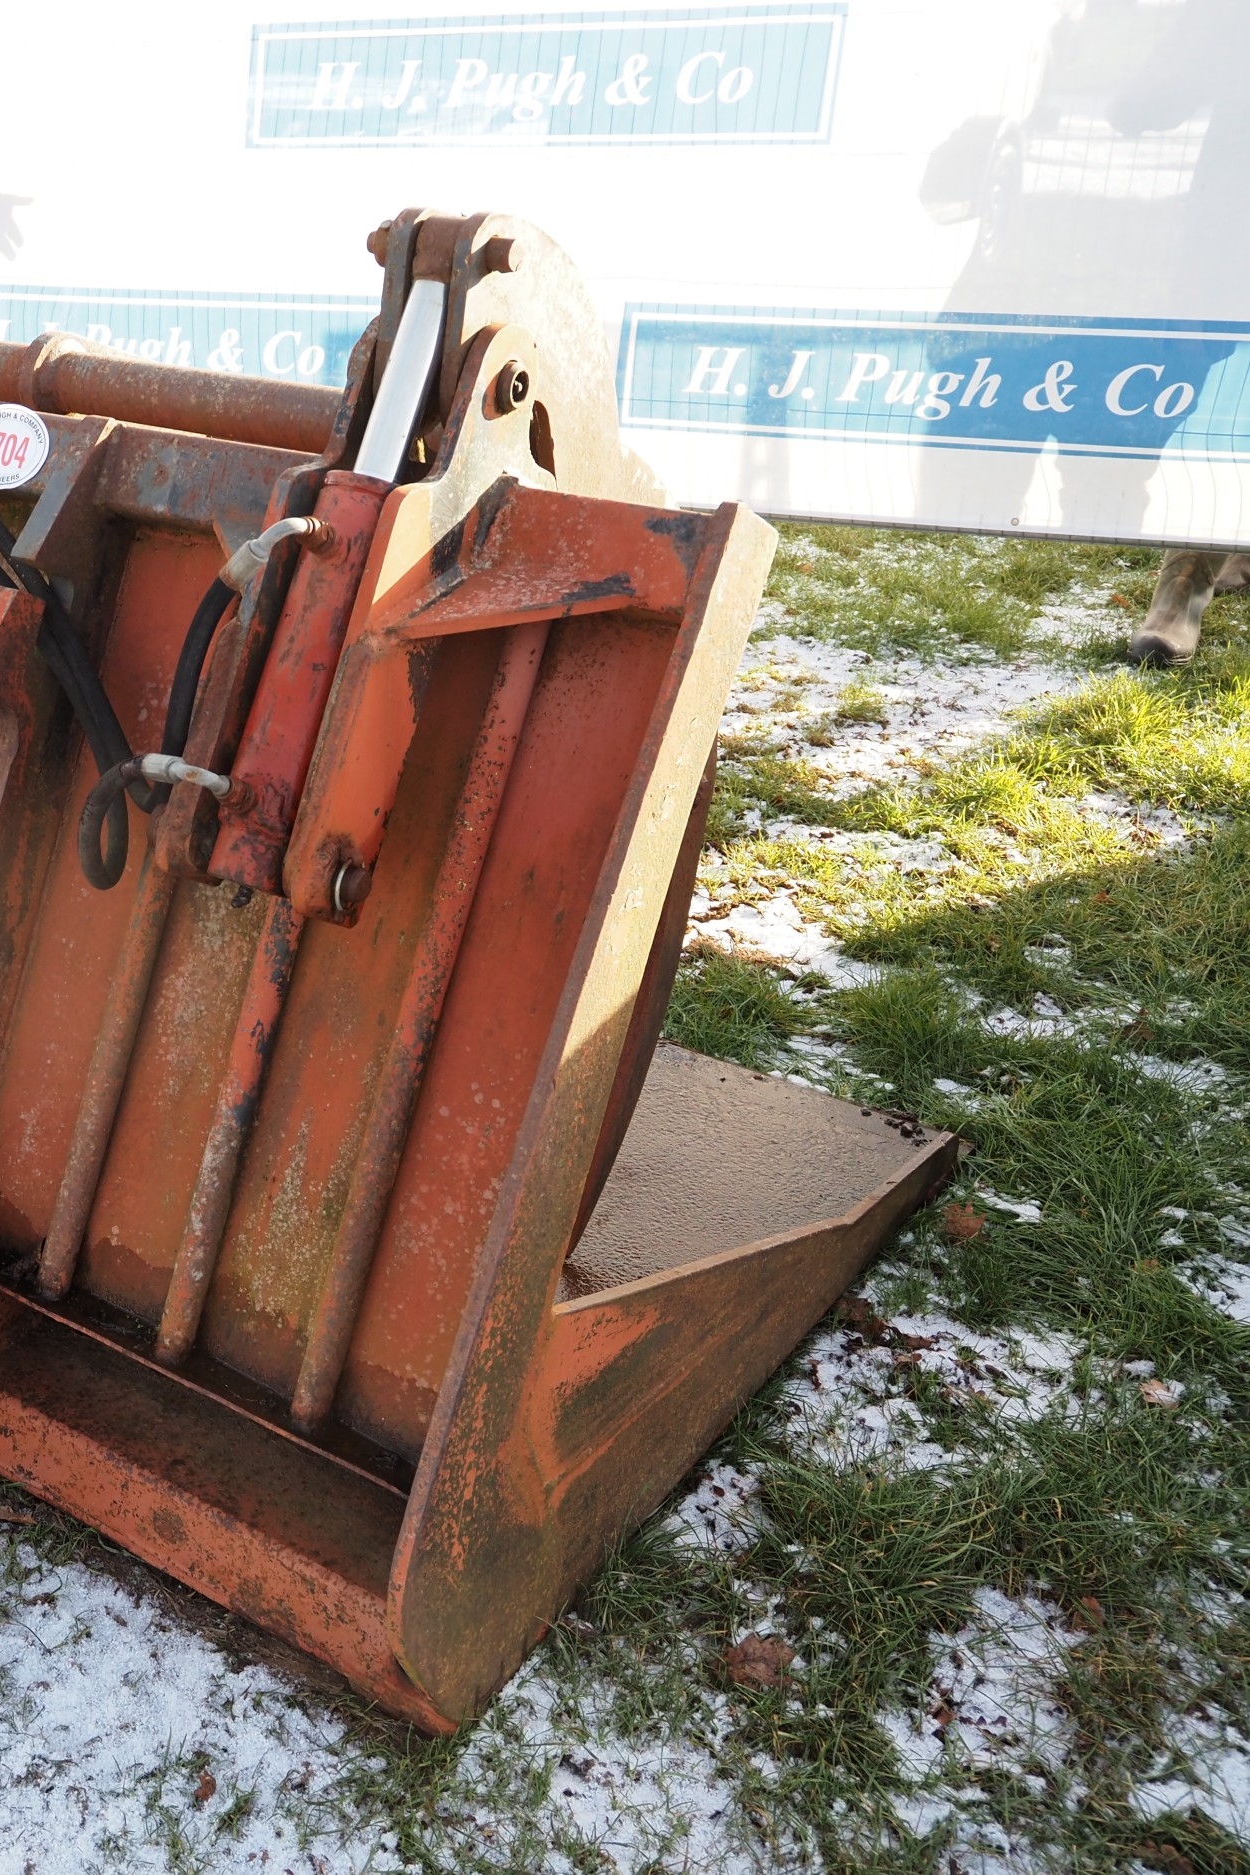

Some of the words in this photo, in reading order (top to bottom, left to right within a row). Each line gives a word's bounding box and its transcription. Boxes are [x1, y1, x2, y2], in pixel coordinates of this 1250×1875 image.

[307, 61, 363, 110] H.
[381, 59, 426, 110] J.
[442, 55, 586, 121] Pugh
[605, 53, 653, 106] &
[676, 50, 754, 104] Co
[206, 328, 244, 372] &
[263, 330, 325, 375] Co
[682, 346, 747, 396] H.
[768, 350, 816, 400] J.
[835, 352, 1002, 421] Pugh
[1023, 360, 1078, 412] &
[1105, 363, 1195, 418] Co
[19, 414, 43, 444] COMPANY
